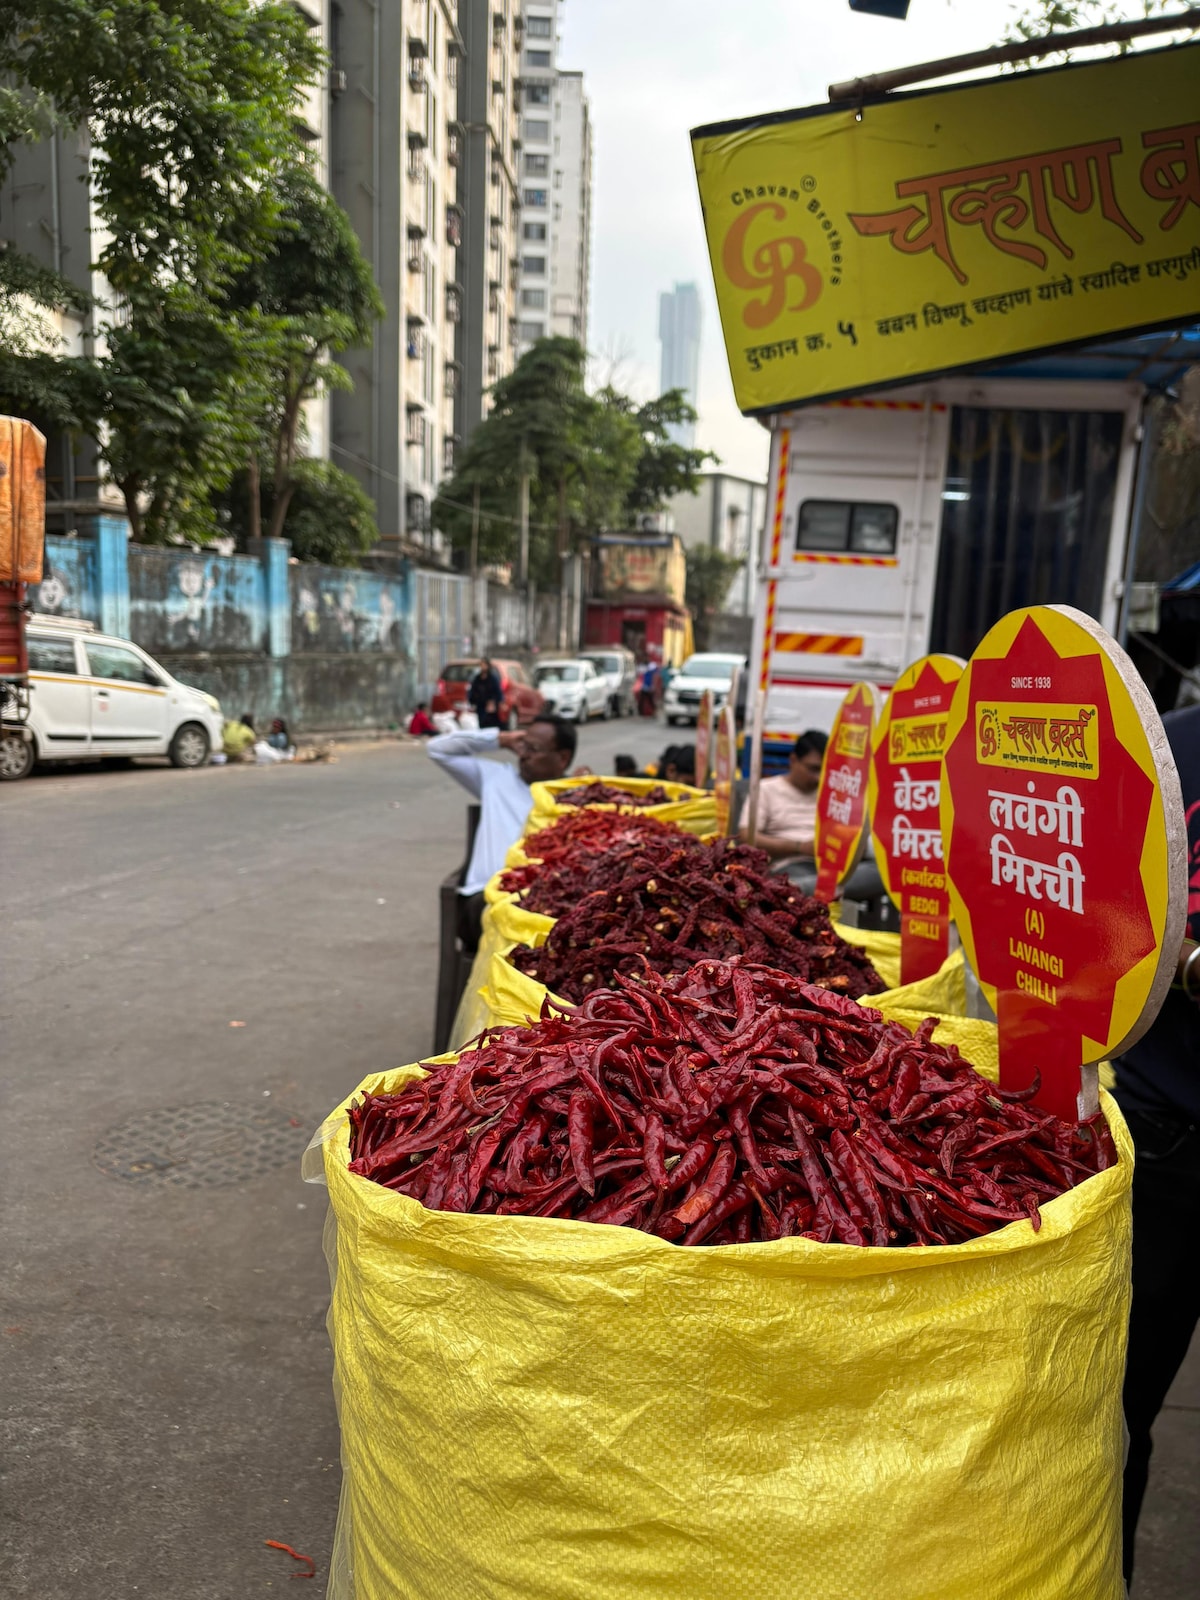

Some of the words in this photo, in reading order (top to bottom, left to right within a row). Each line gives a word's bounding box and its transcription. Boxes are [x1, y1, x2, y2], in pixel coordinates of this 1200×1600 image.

[731, 185, 800, 206] Chavan
[847, 137, 1144, 285] चव्हाण
[807, 198, 842, 286] Brothers
[972, 288, 1032, 317] चव्हाण
[1036, 274, 1074, 302] यांचे
[744, 338, 799, 371] दुकान
[1011, 676, 1033, 689] SINCE
[1034, 676, 1052, 689] 1938
[1001, 716, 1049, 755] चव्हाण
[1049, 708, 1092, 761] ब्रदर्स
[894, 767, 941, 811] बेडग
[987, 781, 1085, 847] लवंगी
[891, 814, 944, 861] मिरच
[990, 833, 1086, 914] मिरची
[909, 895, 939, 916] BEDGI
[1025, 907, 1045, 940] (A)
[908, 919, 940, 940] CHILLI
[1009, 937, 1063, 979] LAVANGI
[1016, 969, 1057, 1006] CHILLI
